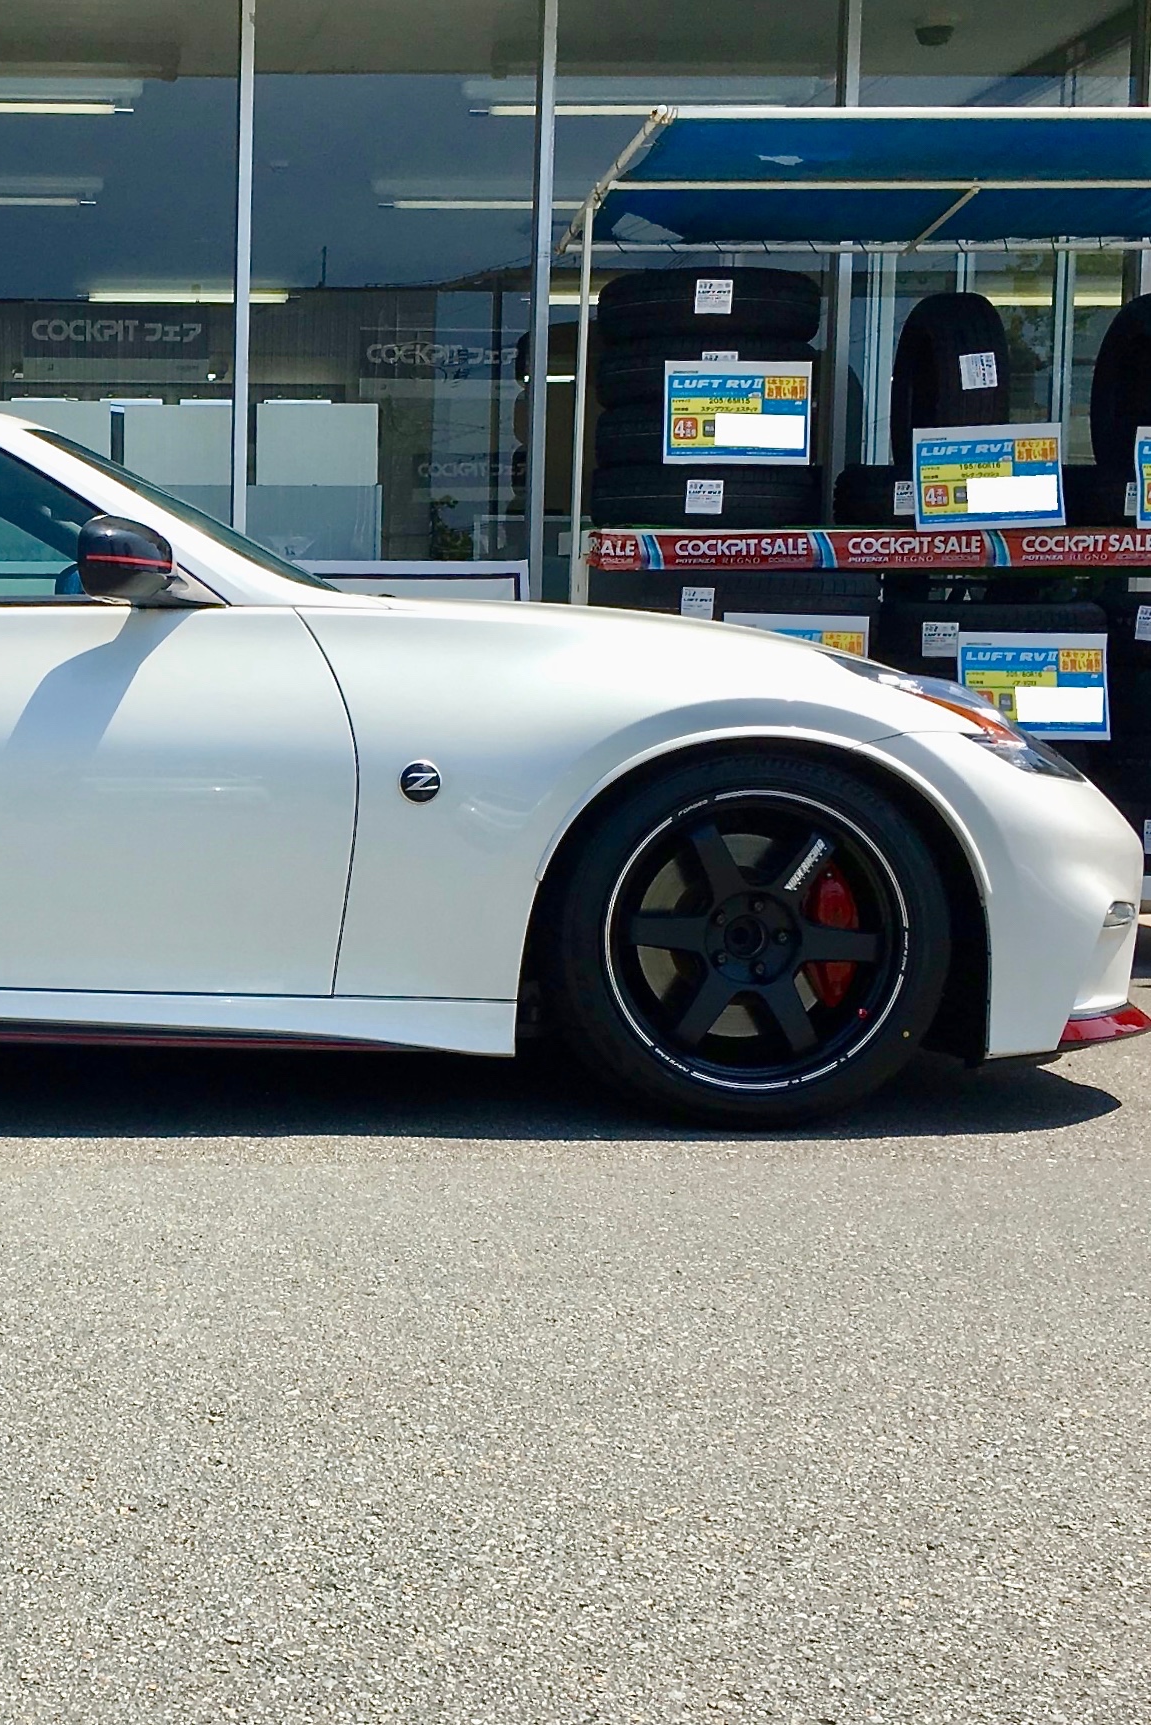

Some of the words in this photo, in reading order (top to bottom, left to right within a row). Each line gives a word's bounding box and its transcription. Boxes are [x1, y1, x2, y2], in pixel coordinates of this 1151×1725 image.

[32, 319, 139, 342] COCKPIT
[144, 323, 202, 342] フェア
[367, 344, 464, 365] COCKPIT
[672, 379, 722, 389] LUFT
[920, 445, 972, 457] LUFT
[674, 539, 758, 556] COCKPIT
[760, 538, 807, 555] SALE
[848, 537, 931, 554] COCKPIT
[934, 536, 981, 553] SALE
[1022, 535, 1106, 552] COCKPIT
[722, 557, 761, 565] REGNO
[1069, 553, 1108, 561] REGNO
[965, 651, 1016, 662] LUFT
[405, 773, 438, 791] Z
